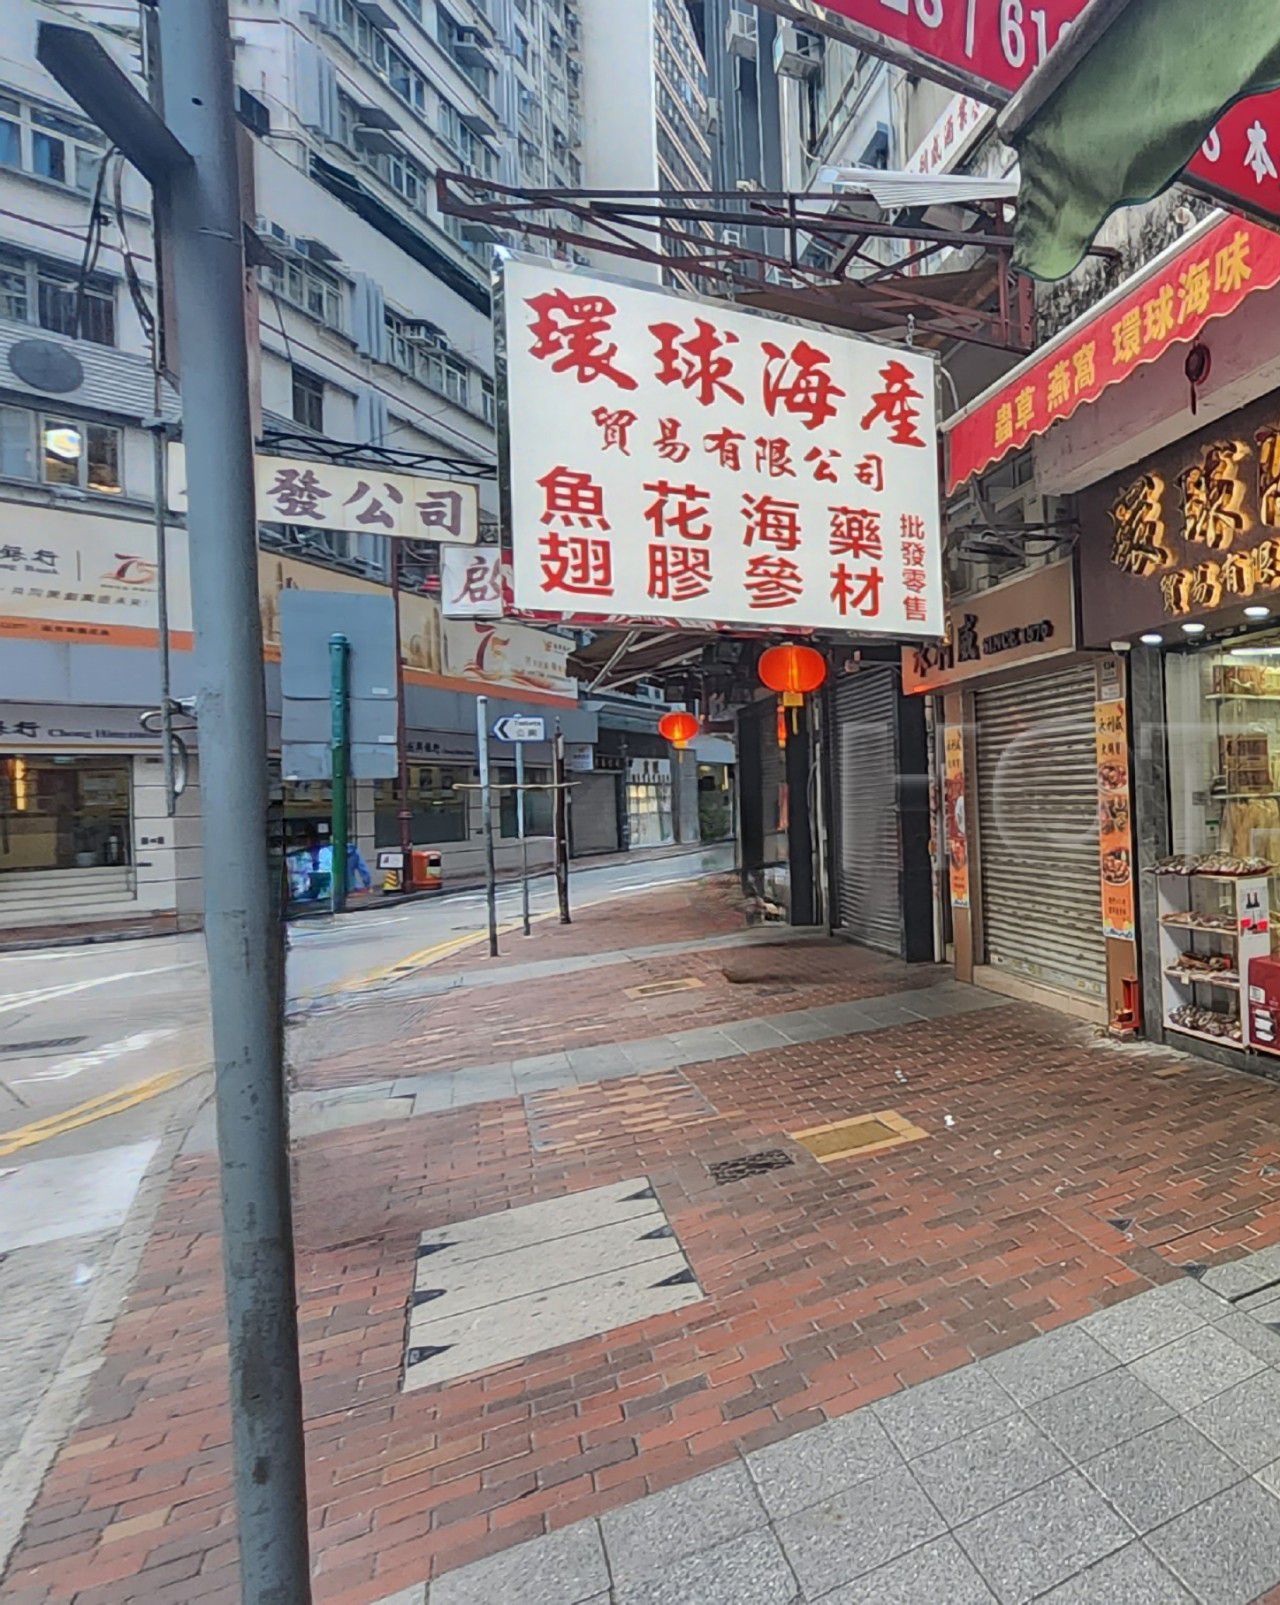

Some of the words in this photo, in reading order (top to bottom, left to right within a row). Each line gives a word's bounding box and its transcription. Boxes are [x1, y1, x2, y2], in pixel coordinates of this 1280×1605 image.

[522, 288, 927, 447] 環球海產
[1046, 340, 1096, 412] 燕窩
[1111, 231, 1253, 366] 環球海味
[265, 468, 463, 537] 發公司
[591, 406, 885, 492] 貿易有限公司
[536, 465, 615, 597] 魚翅
[643, 480, 713, 602] 花膠
[740, 493, 804, 610] 海參
[827, 505, 883, 618] 藥材
[900, 513, 927, 622] 批發零售
